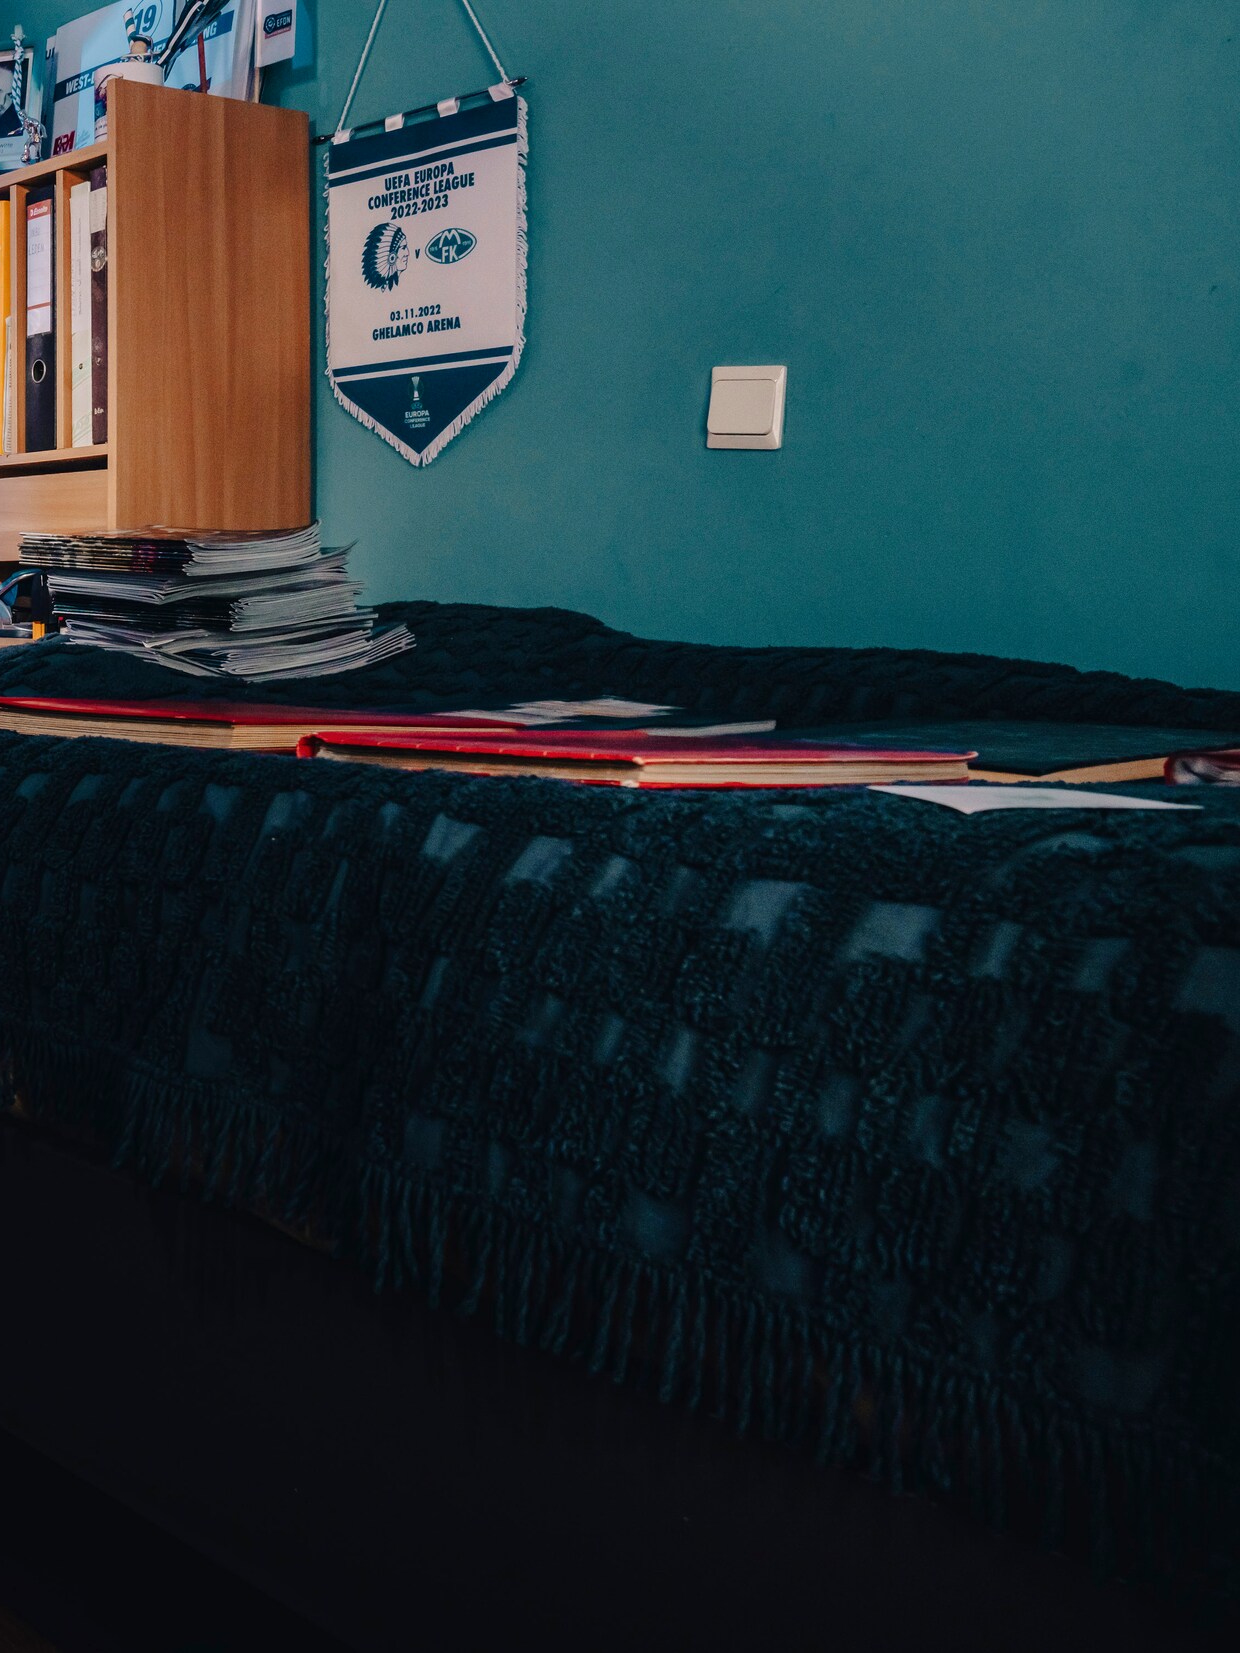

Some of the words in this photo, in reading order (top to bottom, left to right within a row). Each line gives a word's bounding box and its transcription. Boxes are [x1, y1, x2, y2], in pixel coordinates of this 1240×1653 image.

[384, 173, 411, 191] UEFA
[414, 161, 455, 185] EUROPA
[368, 183, 431, 210] CONFERENCE
[433, 172, 475, 195] LEAGUE
[390, 194, 449, 220] 2022-2023
[389, 304, 441, 321] 03.11.2022
[372, 322, 424, 340] GHELAMCO
[426, 316, 461, 333] ARENA
[404, 410, 430, 418] EUROPA
